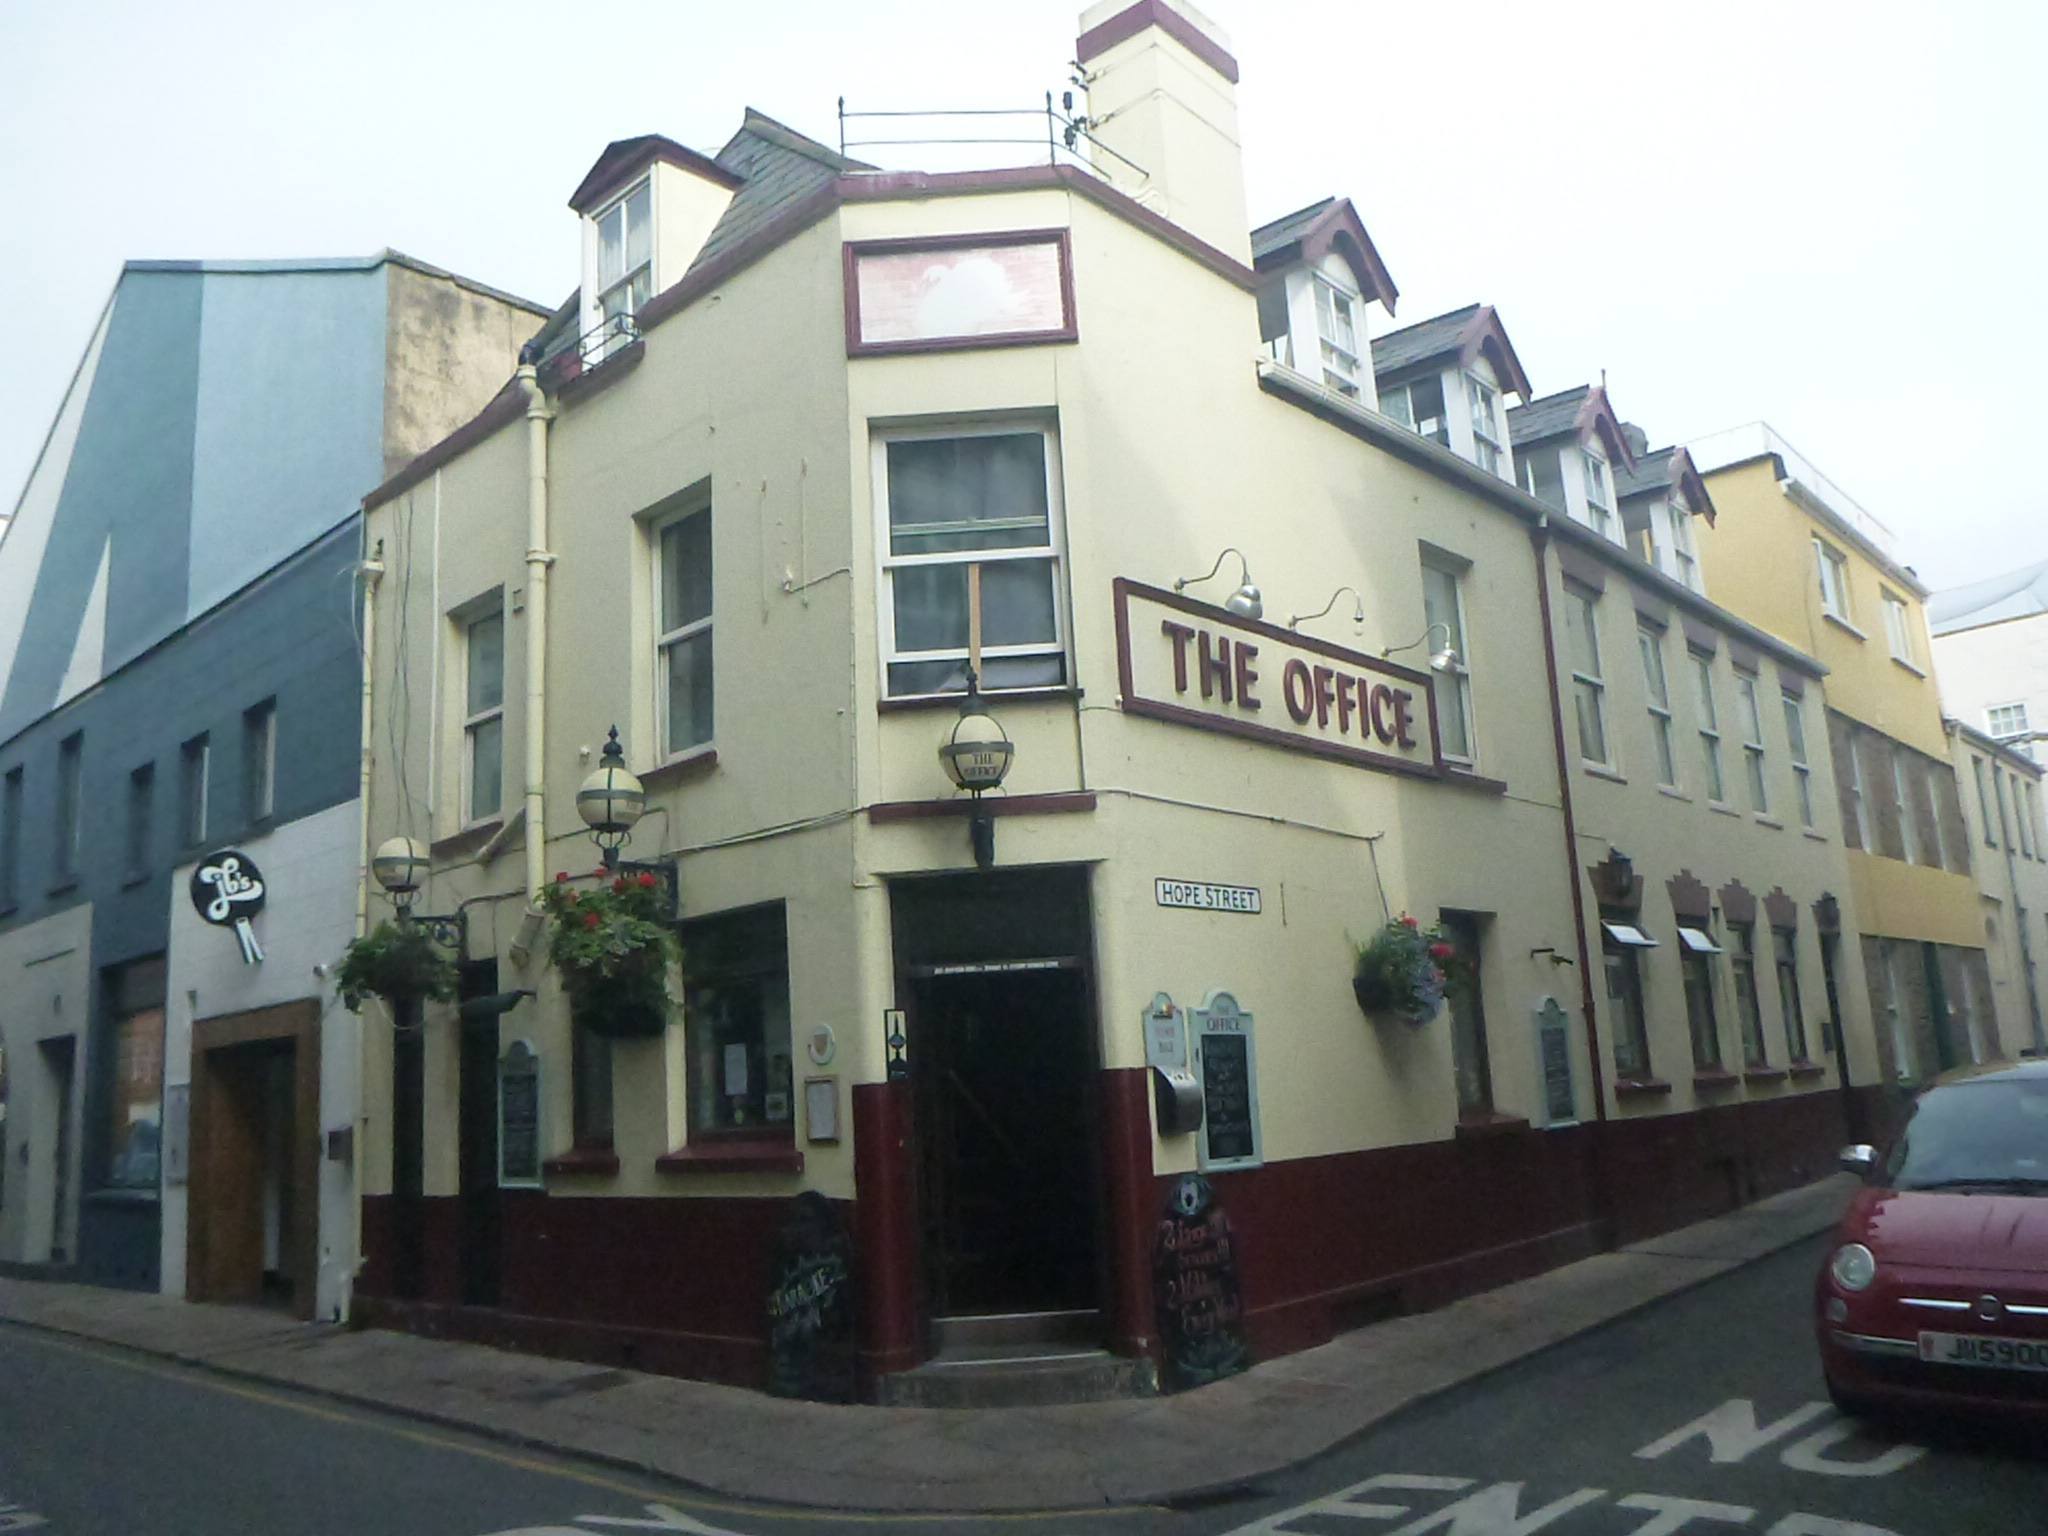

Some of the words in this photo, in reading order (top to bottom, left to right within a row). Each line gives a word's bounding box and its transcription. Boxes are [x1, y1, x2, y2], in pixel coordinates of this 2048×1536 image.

[1161, 619, 1261, 713] THE
[1284, 658, 1416, 750] OFFICE
[1163, 883, 1201, 905] HOPE
[1205, 887, 1255, 909] STREET
